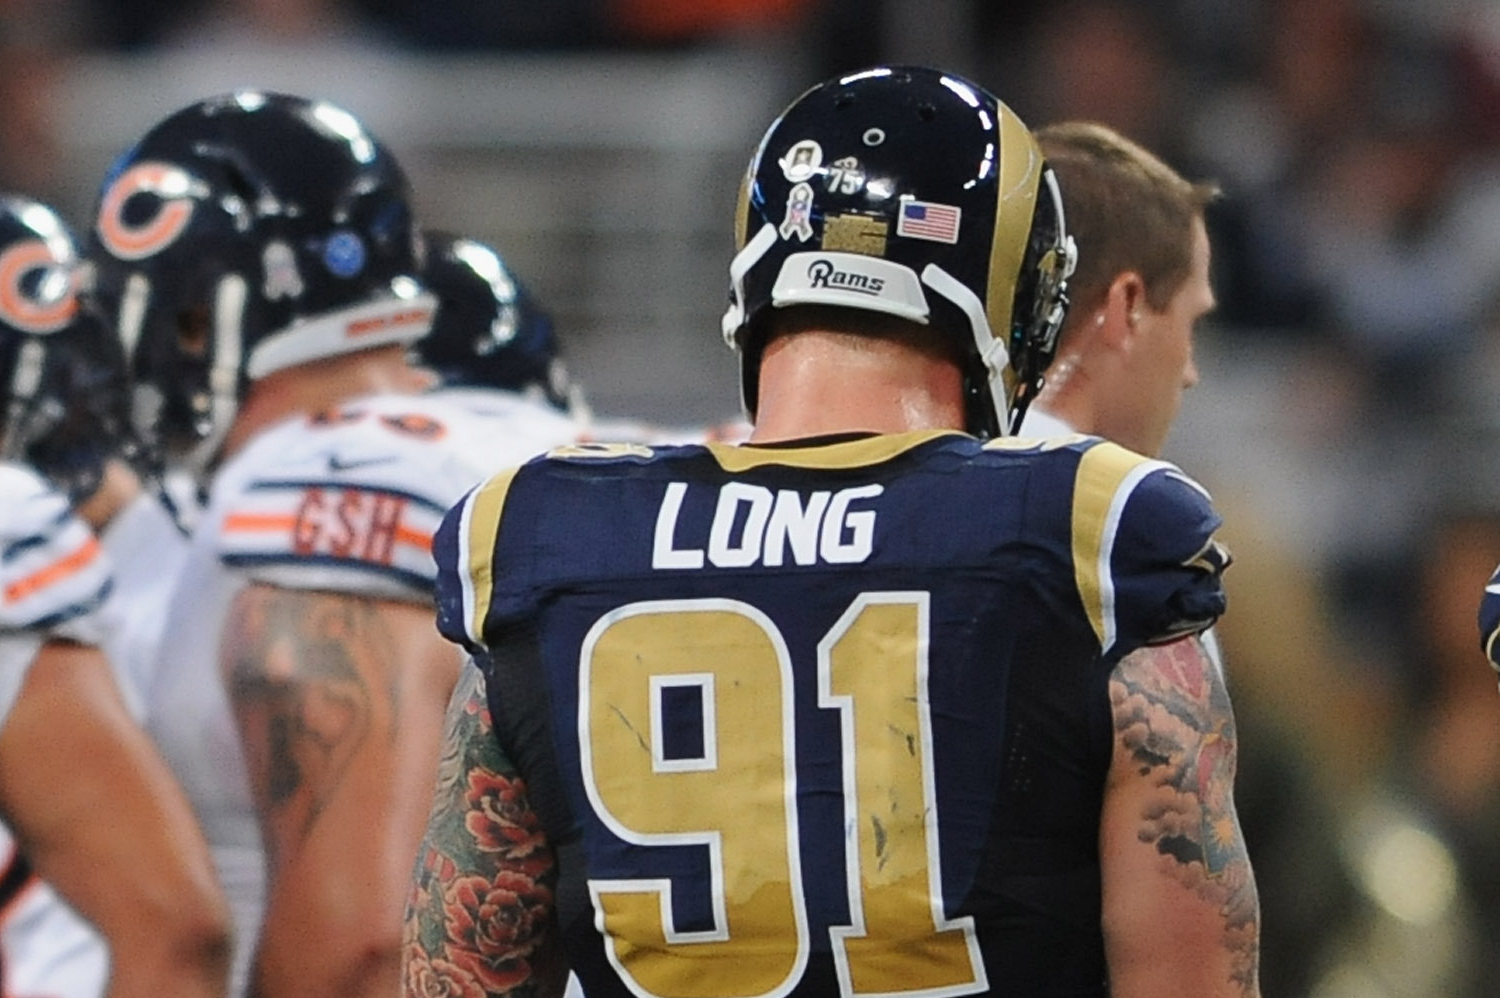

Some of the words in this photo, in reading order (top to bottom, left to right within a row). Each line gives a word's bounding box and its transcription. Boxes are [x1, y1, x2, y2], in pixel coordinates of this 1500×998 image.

[827, 167, 863, 195] 75
[807, 259, 886, 296] Rams
[292, 484, 407, 568] GSH
[652, 481, 885, 570] LONG
